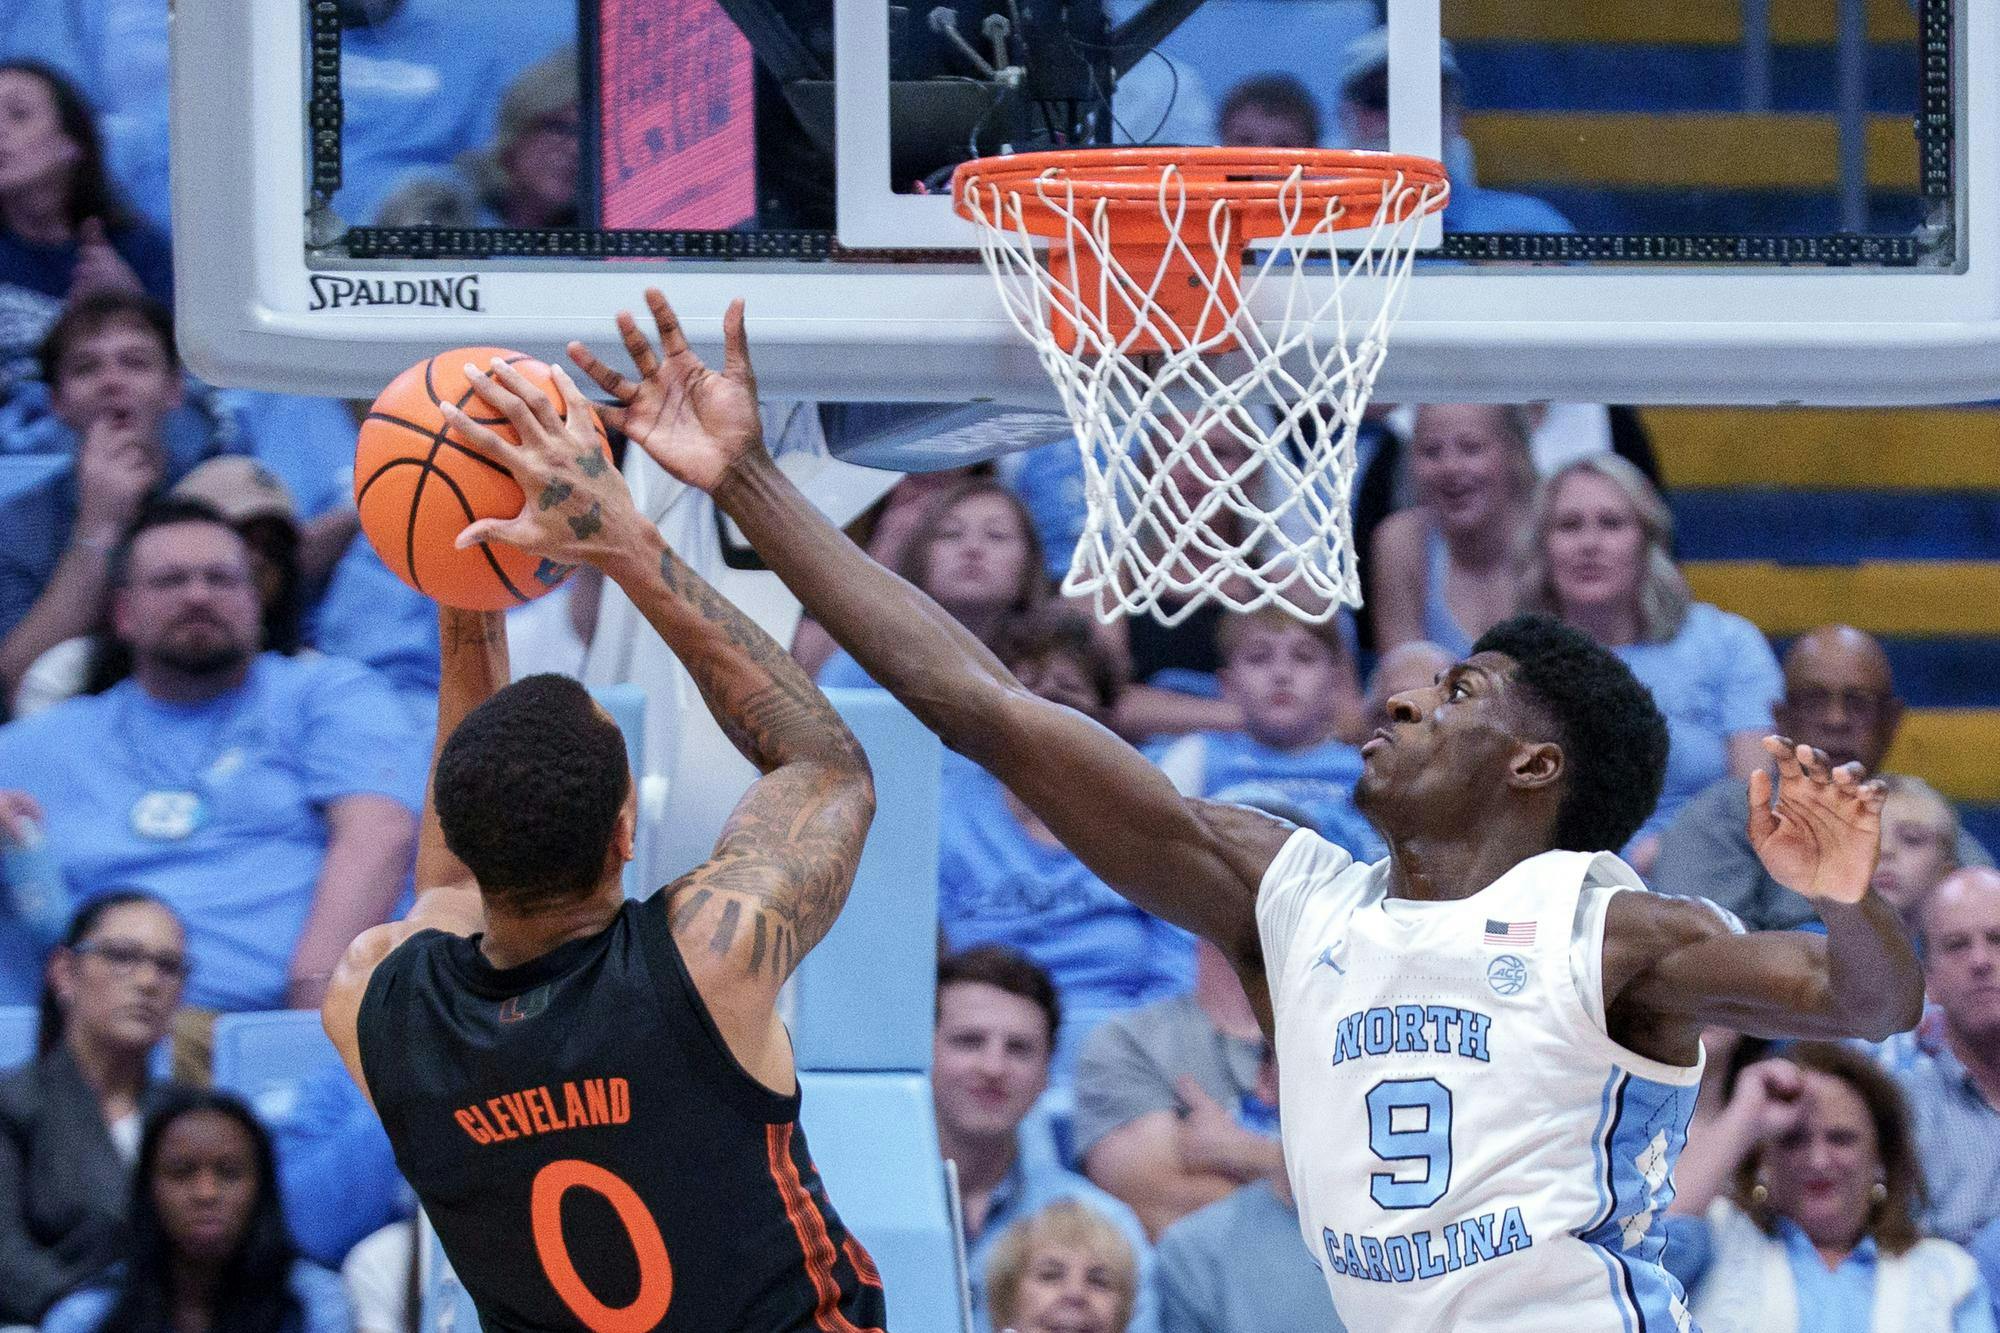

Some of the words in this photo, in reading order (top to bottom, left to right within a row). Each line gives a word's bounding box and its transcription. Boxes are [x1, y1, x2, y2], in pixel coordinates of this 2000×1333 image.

[309, 273, 481, 312] SPALDING
[1493, 968, 1525, 979] ACC
[1332, 1004, 1492, 1066] NORTH
[453, 1076, 632, 1145] CLEVELAND
[1364, 1076, 1454, 1210] 9
[530, 1158, 675, 1333] 0
[1322, 1205, 1533, 1283] CAROLINA
